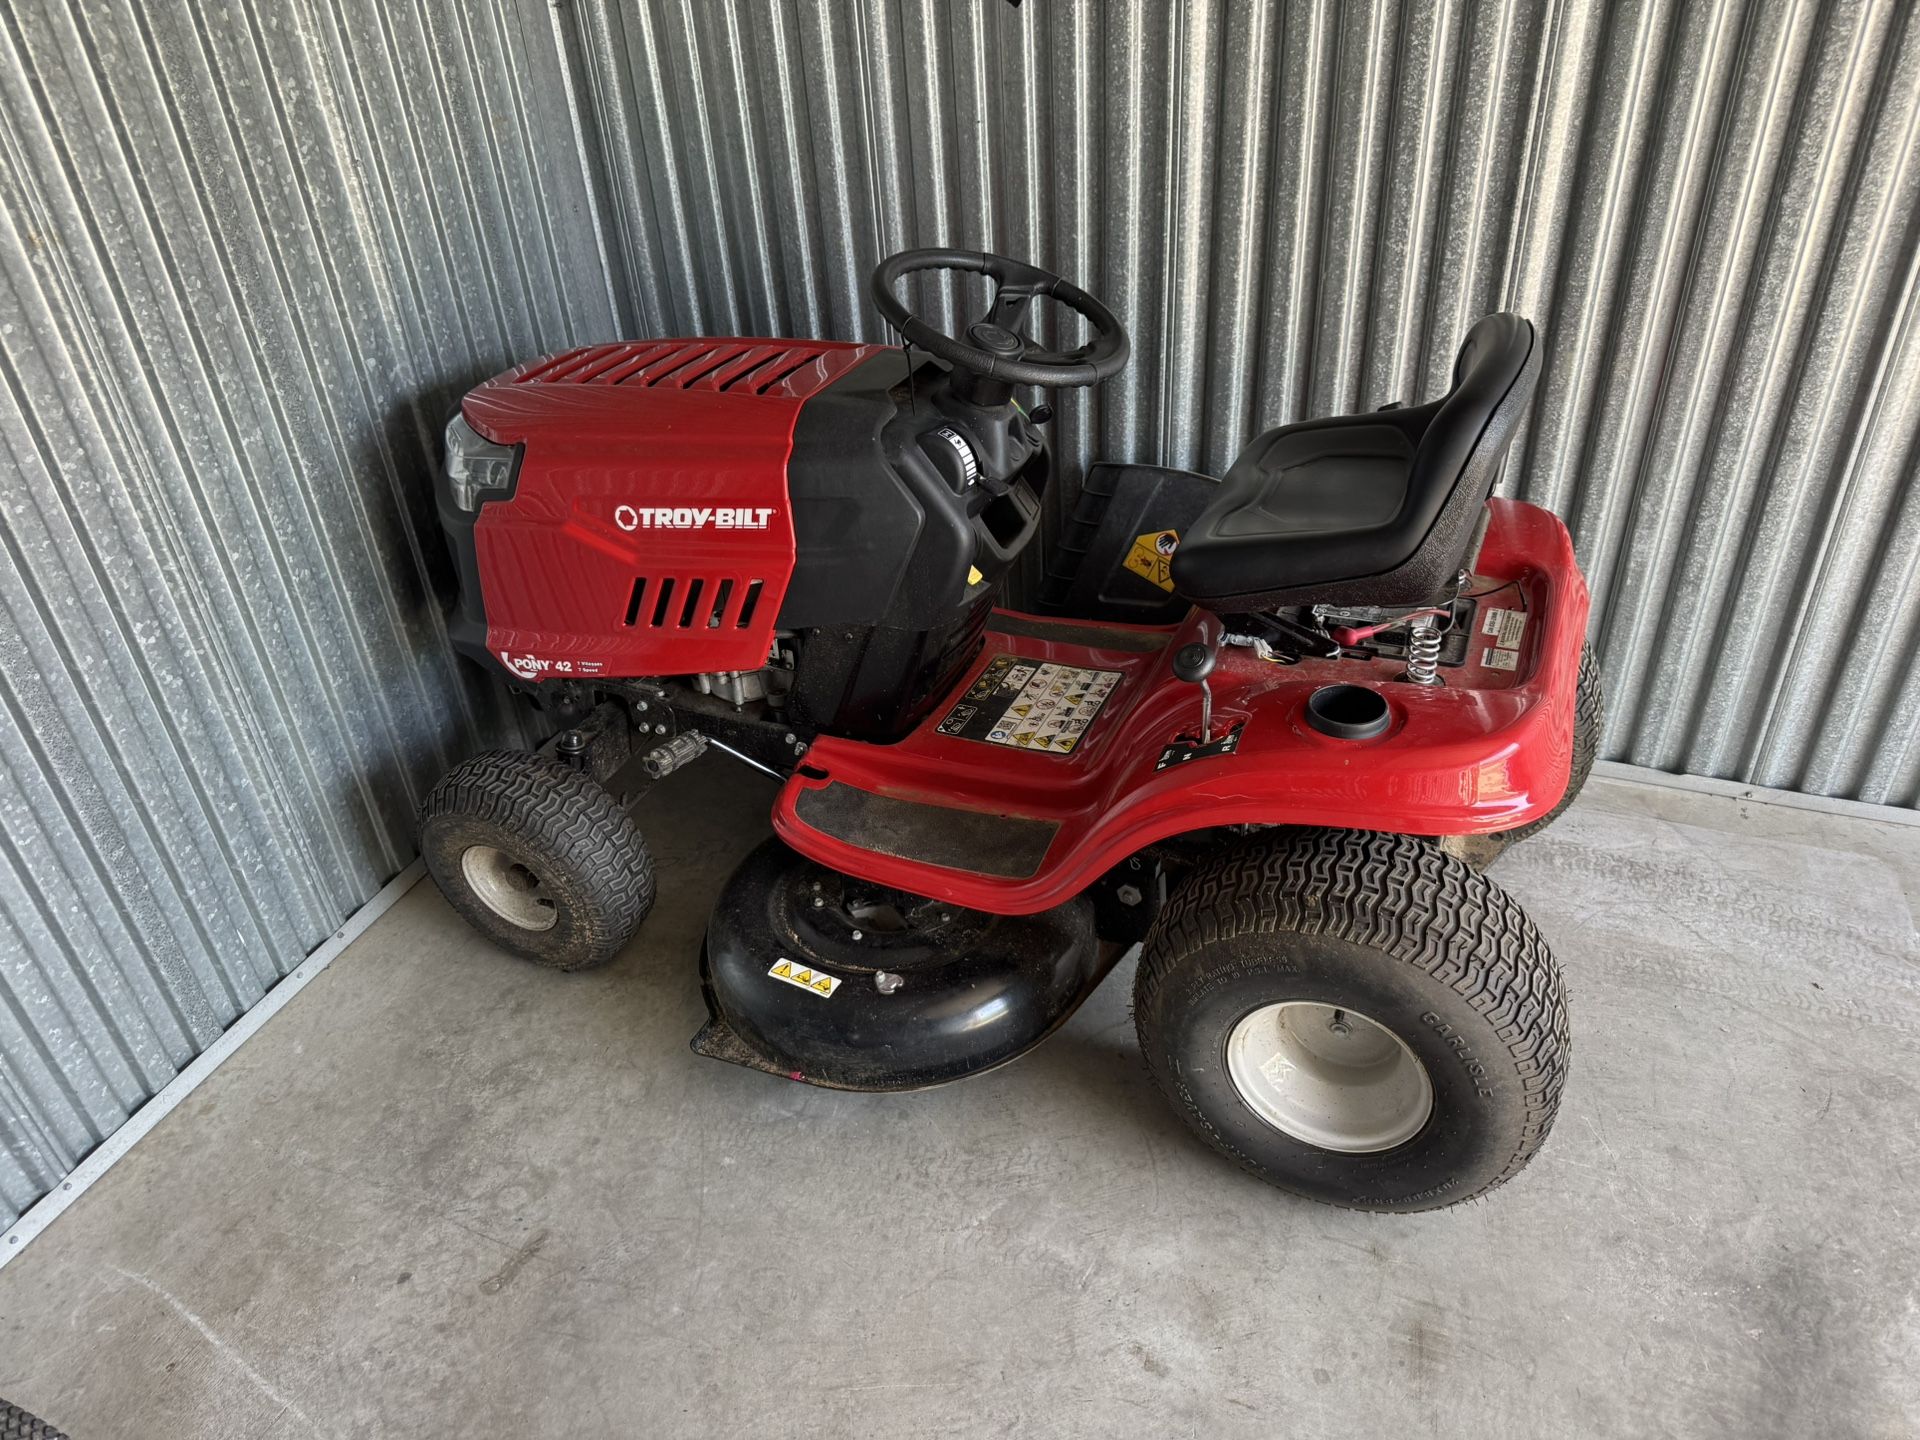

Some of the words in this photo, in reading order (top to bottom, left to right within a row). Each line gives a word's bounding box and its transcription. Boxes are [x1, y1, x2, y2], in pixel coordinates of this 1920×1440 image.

[639, 508, 772, 529] TROY-BILT
[514, 658, 550, 671] PONY
[555, 661, 573, 672] 42
[1421, 1011, 1494, 1097] CARLISLE
